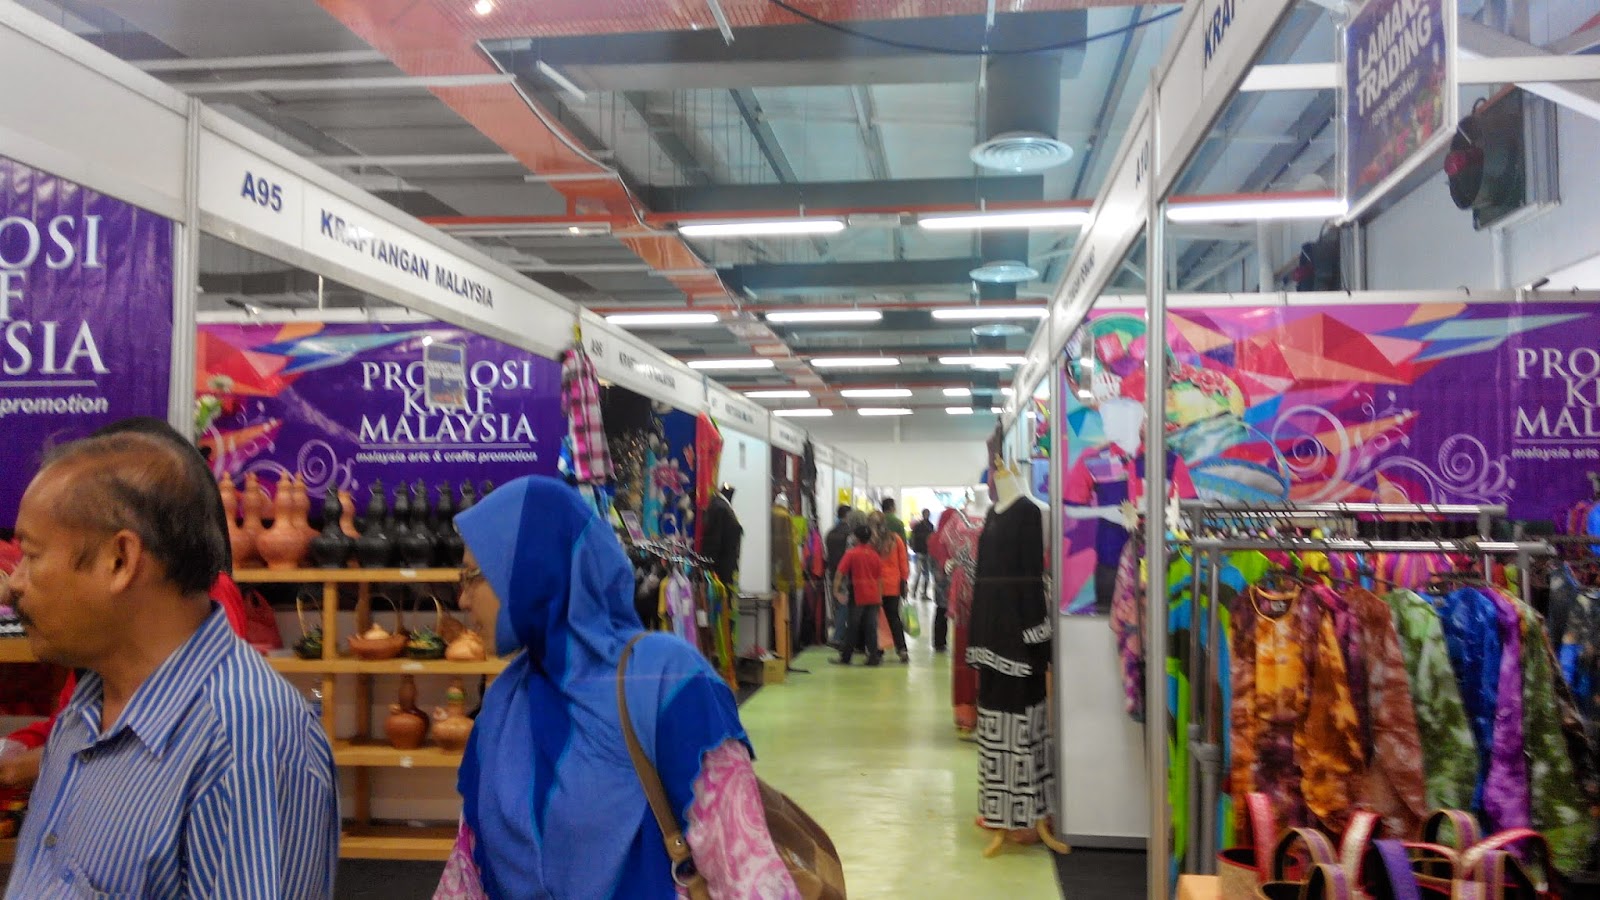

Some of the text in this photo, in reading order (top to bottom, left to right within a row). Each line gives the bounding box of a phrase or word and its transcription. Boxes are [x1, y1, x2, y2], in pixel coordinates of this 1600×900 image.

[1356, 4, 1431, 117] TRADING
[241, 171, 283, 212] A95
[434, 264, 494, 308] MALAYSIA
[361, 359, 533, 391] PROOSI
[1564, 376, 1600, 408] K
[358, 412, 539, 443] MALAYSIA
[356, 449, 538, 465] malaysia arts & crafts promotion
[1511, 446, 1572, 461] malaysia
